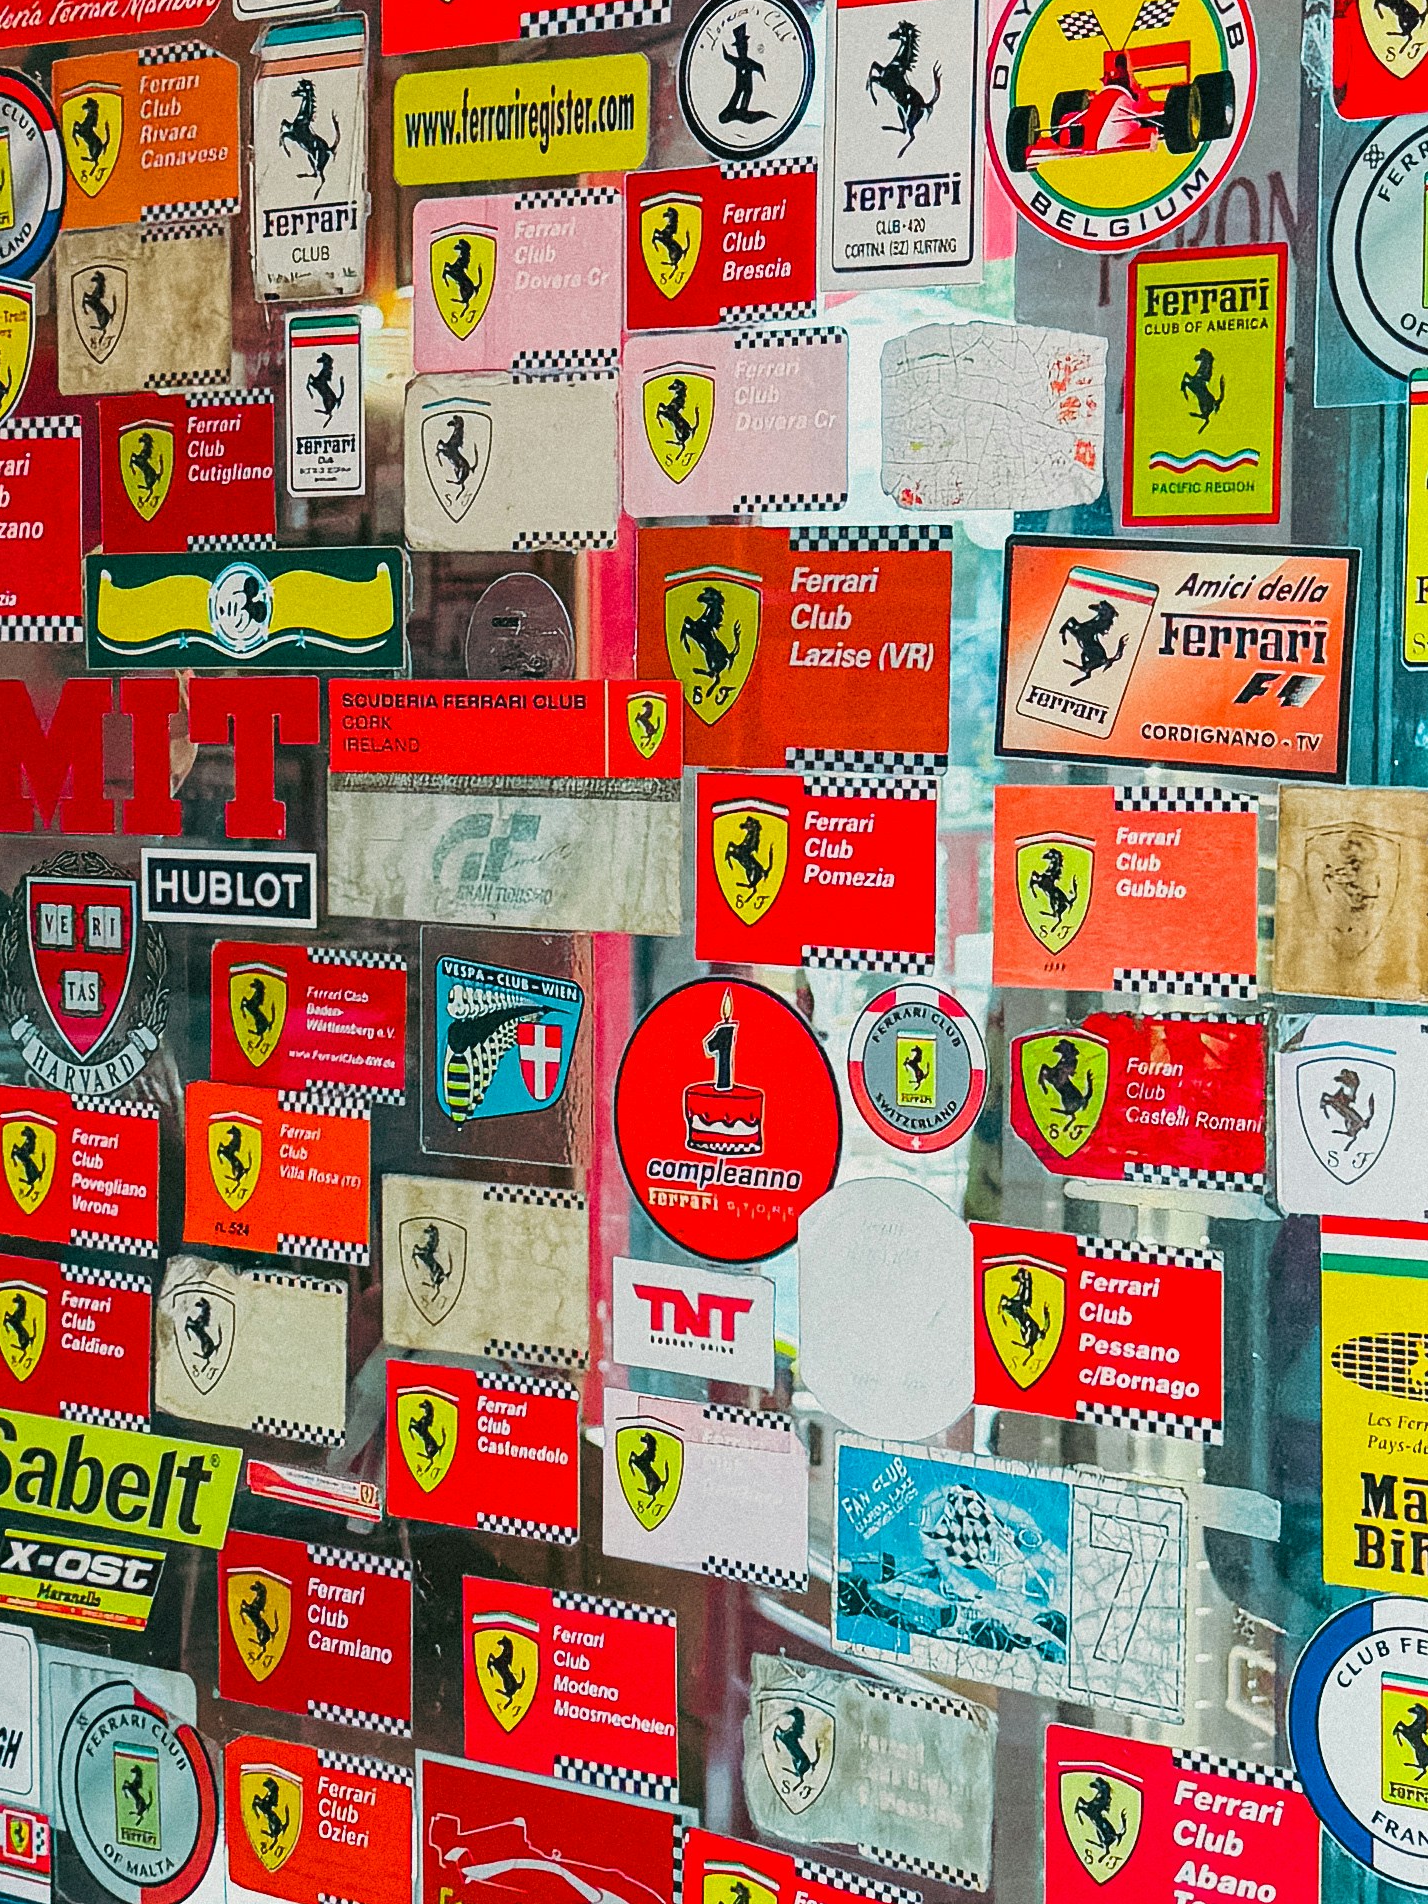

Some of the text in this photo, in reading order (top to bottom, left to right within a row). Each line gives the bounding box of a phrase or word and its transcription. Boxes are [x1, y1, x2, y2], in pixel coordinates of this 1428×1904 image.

[405, 85, 634, 154] www.ferrariregister.com
[1028, 167, 1213, 237] BELGIUM
[1144, 277, 1268, 317] Ferrari
[1144, 317, 1269, 334] CLUB OF AMERICA
[1175, 572, 1329, 604] Amici della
[1158, 612, 1327, 665] Ferrari
[1141, 724, 1320, 752] CORDIGNANO TV
[154, 865, 304, 910] HUBLOT
[28, 1043, 138, 1092] HARVARD
[646, 1156, 802, 1192] compleanno
[1078, 1270, 1161, 1297] Ferrari
[632, 1284, 754, 1343] TNT
[1078, 1302, 1133, 1327] Club
[1078, 1335, 1180, 1364] Pessano
[1078, 1367, 1200, 1401] c/Bornago
[1336, 1638, 1391, 1690] CLUB
